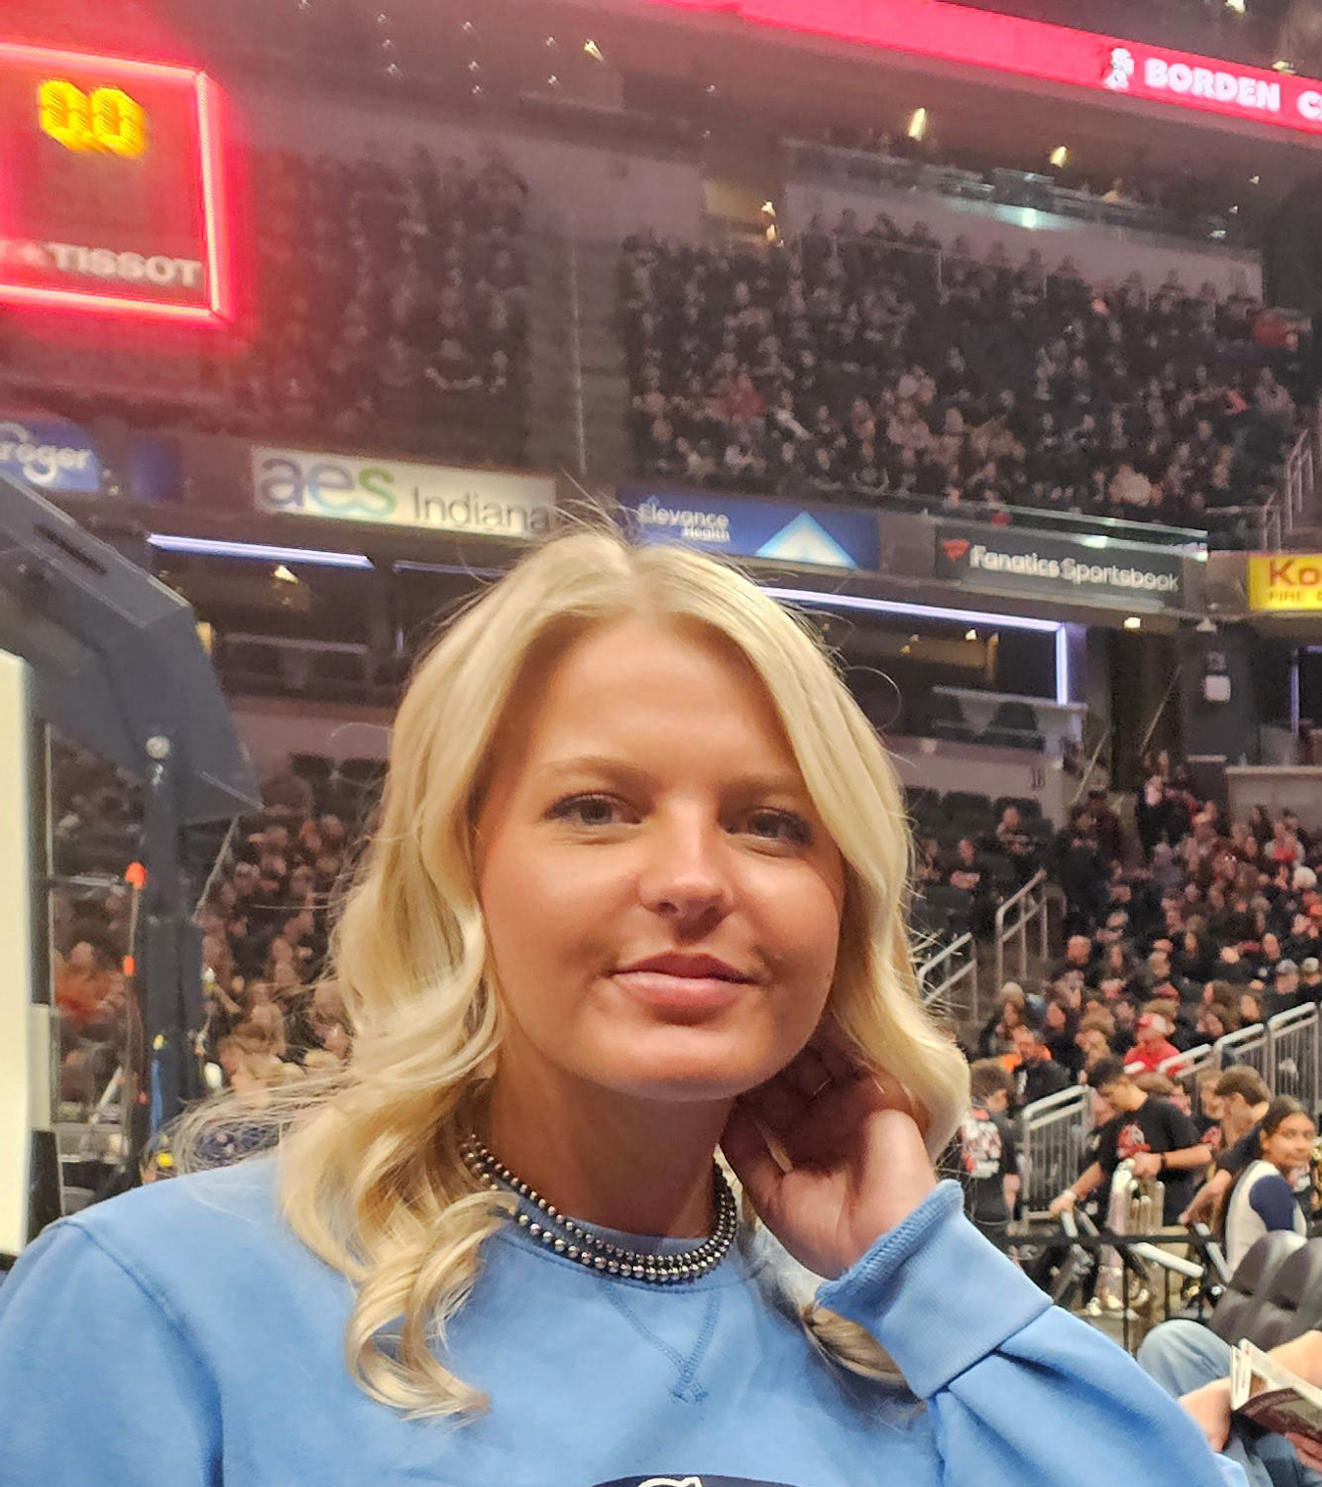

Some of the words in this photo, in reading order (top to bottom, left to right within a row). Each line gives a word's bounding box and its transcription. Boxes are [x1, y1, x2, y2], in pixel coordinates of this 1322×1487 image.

[1143, 57, 1281, 112] BORDEN
[46, 242, 202, 286] TISSOT
[259, 458, 396, 519] aes
[411, 485, 552, 534] Indiana
[970, 545, 1061, 578] Fanatics
[1061, 557, 1181, 592] Sportsbook
